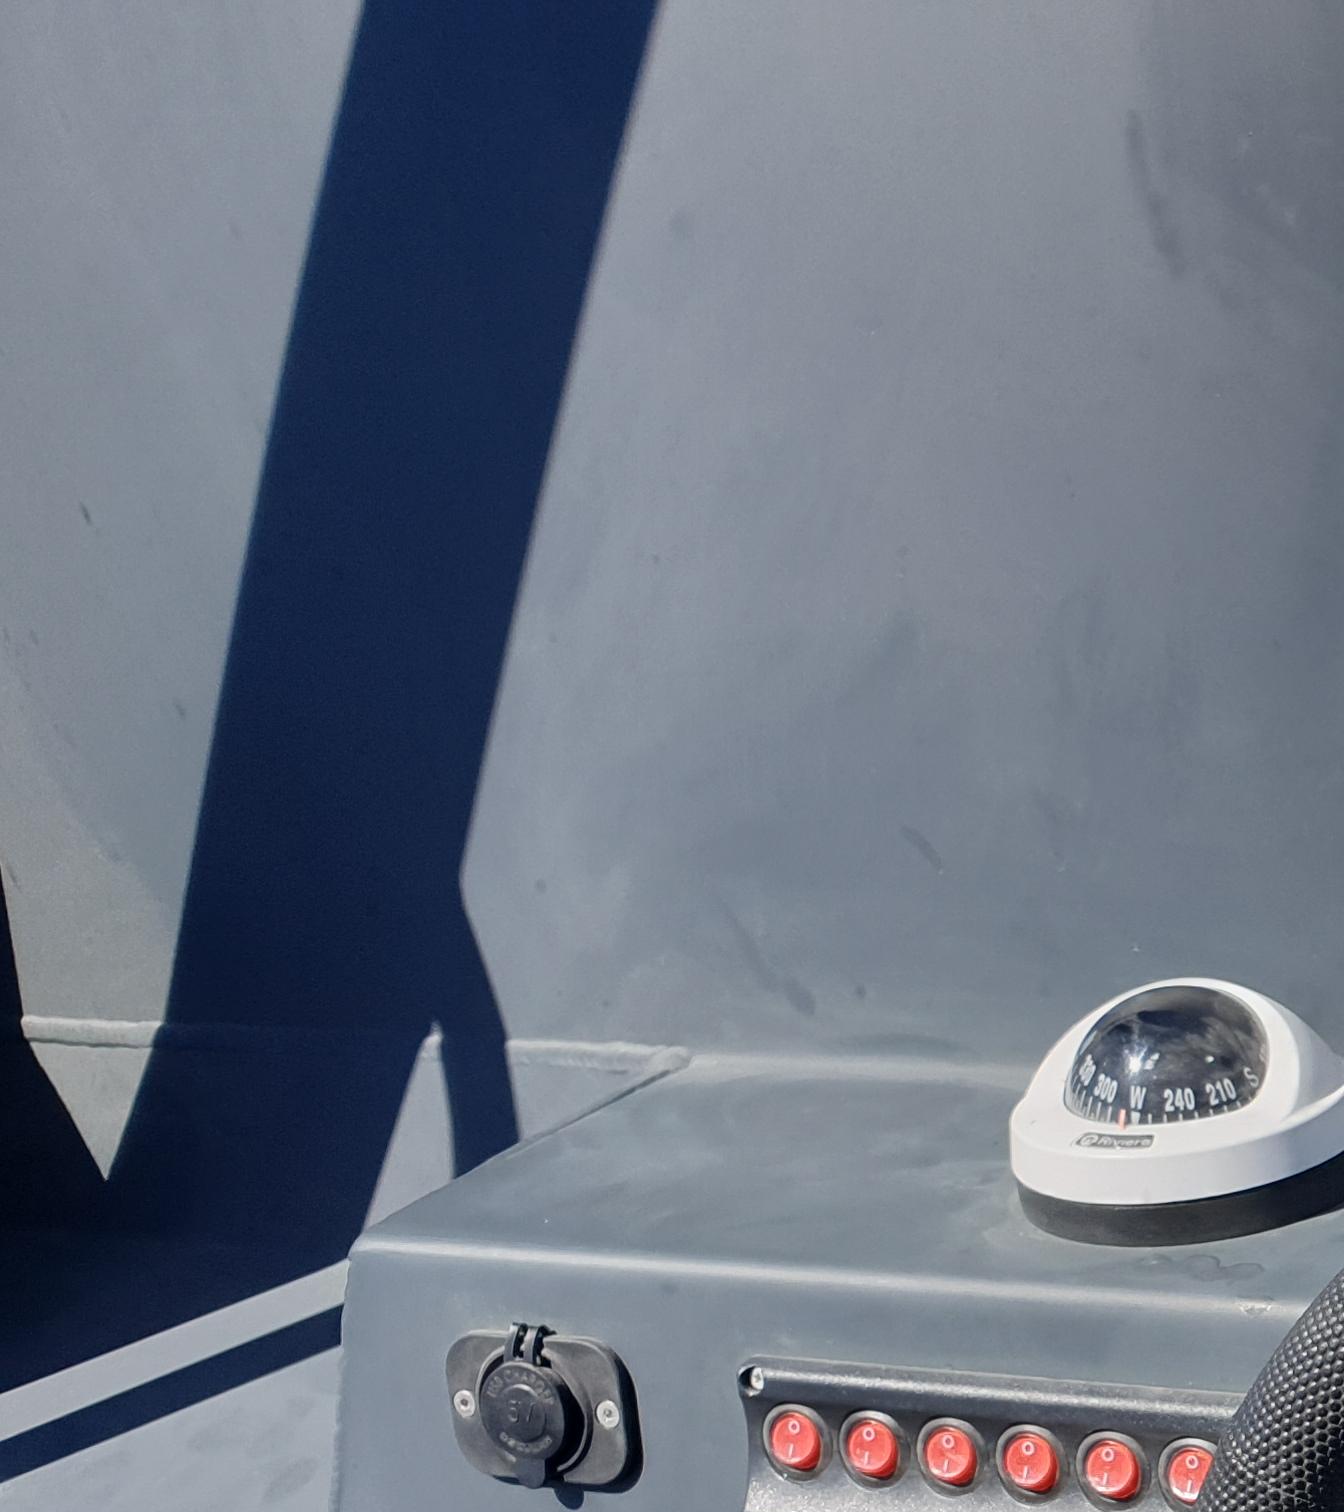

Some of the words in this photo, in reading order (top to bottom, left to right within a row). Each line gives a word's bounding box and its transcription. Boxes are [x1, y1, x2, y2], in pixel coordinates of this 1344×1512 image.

[1094, 1073, 1118, 1104] 300
[1130, 1085, 1147, 1110] W
[1164, 1088, 1196, 1113] 240
[1205, 1078, 1237, 1106] 210
[1244, 1067, 1260, 1089] S
